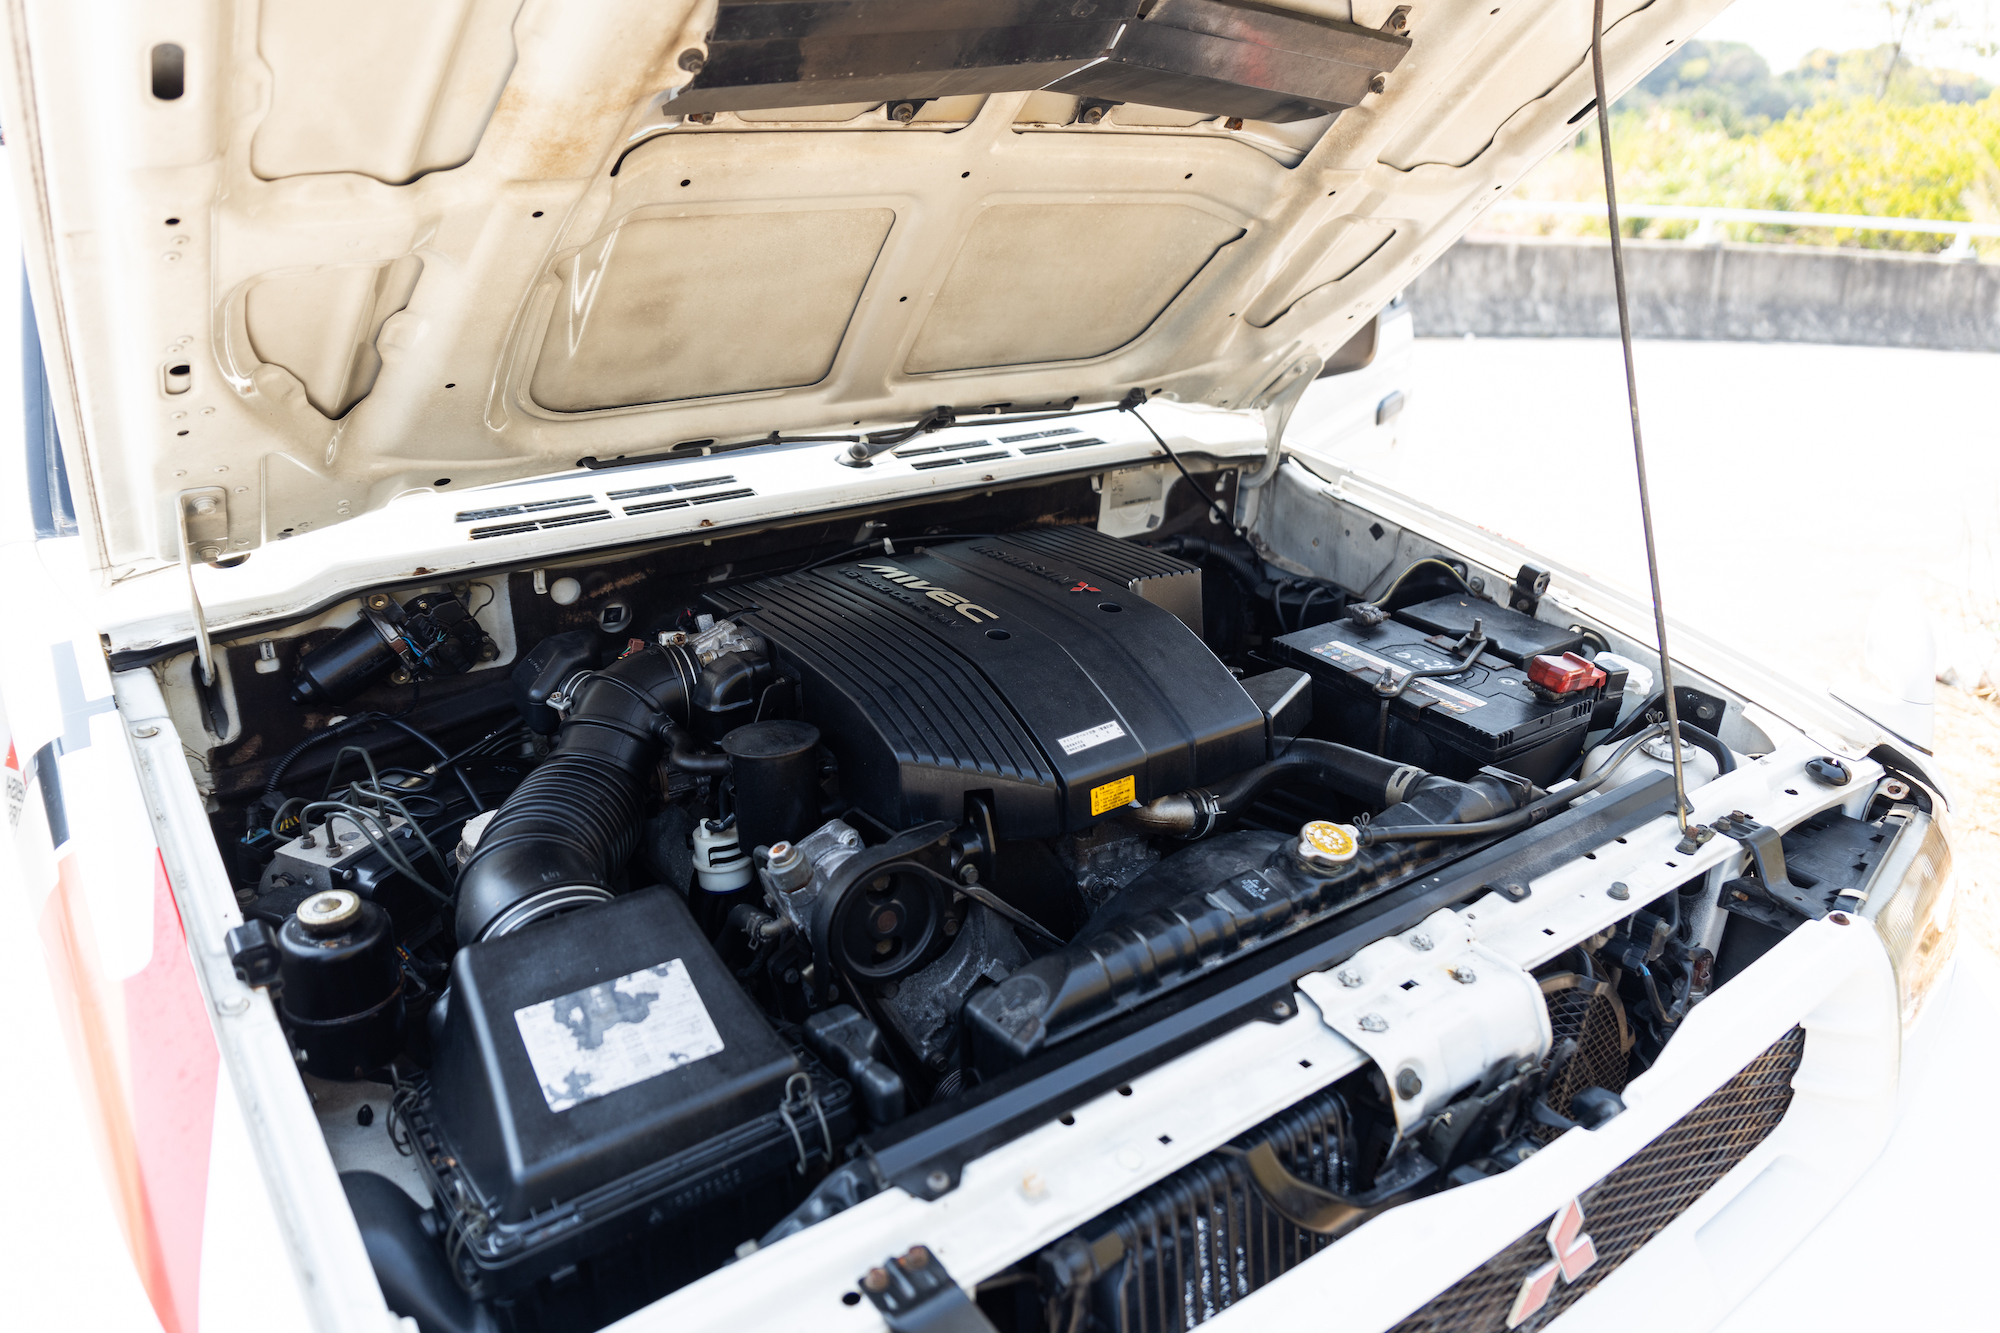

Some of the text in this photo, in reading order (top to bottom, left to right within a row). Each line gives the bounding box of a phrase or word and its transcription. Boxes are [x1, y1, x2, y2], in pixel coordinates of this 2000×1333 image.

[838, 566, 860, 580] V6
[858, 576, 893, 595] 3500
[857, 563, 1000, 624] MIVEC
